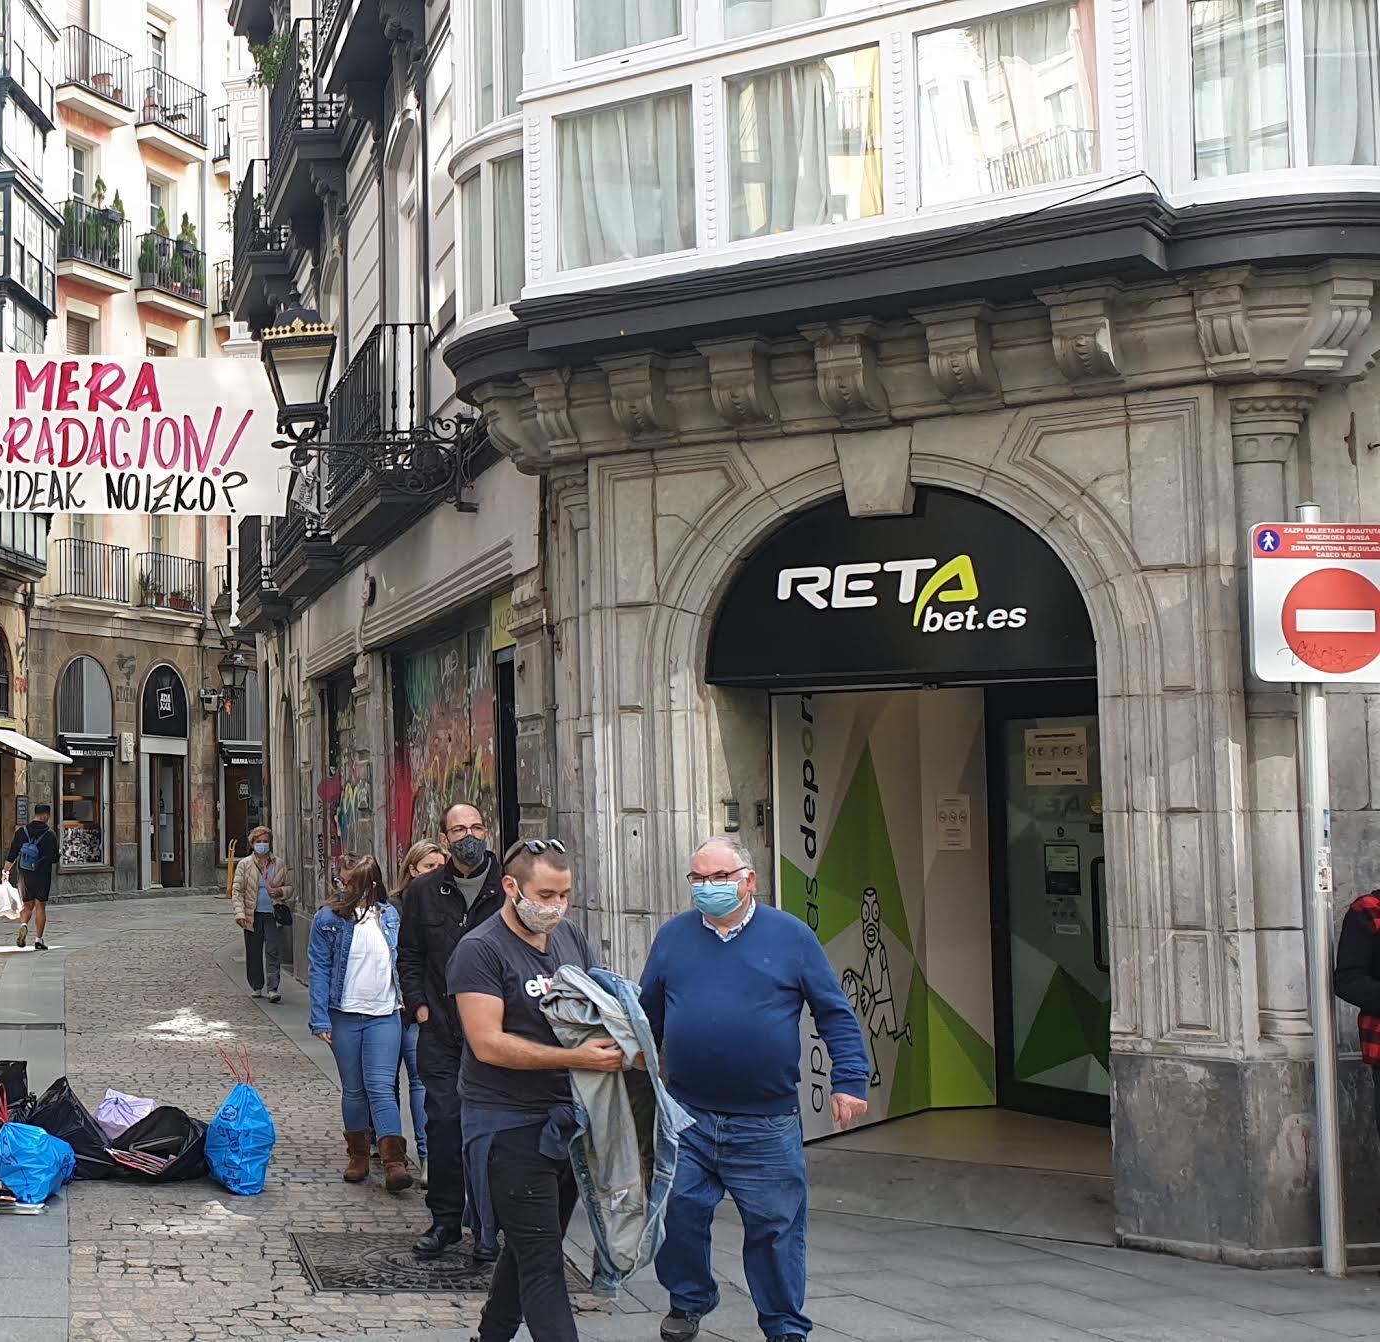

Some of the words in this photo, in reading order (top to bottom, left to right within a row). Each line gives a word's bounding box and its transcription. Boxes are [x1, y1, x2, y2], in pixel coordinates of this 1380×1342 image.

[16, 359, 163, 412] MERA
[105, 471, 249, 513] NOIZKO?
[777, 554, 979, 627] RETA
[922, 605, 1028, 633] bet.es
